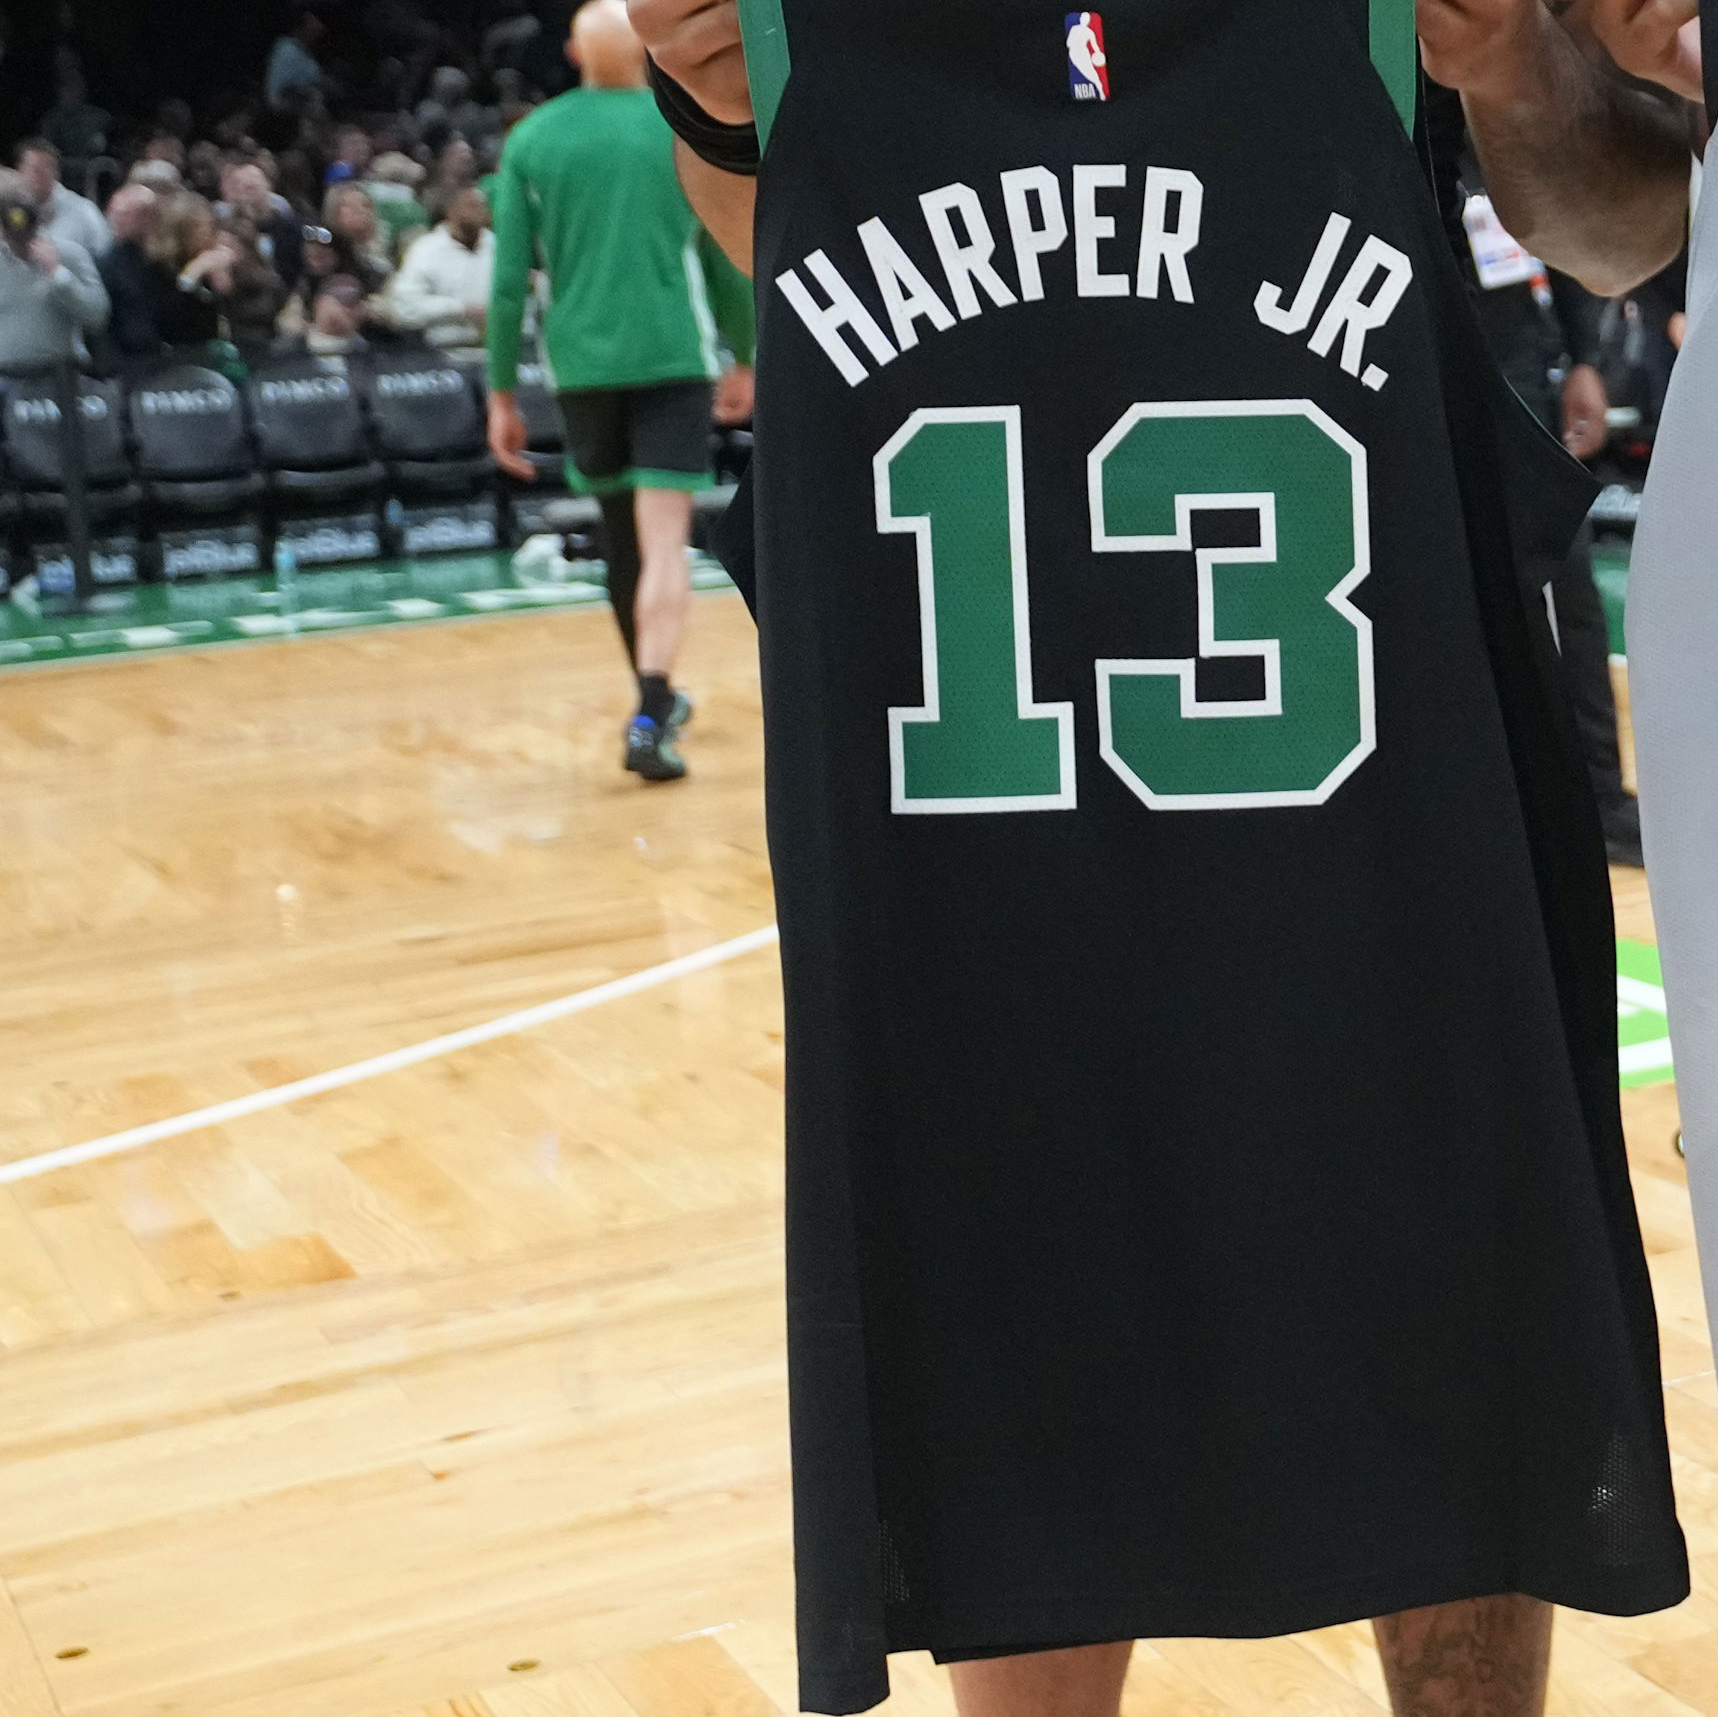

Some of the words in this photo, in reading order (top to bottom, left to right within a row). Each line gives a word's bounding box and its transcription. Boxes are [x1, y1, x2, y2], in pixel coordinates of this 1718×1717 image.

[1073, 82, 1098, 101] NBA
[775, 163, 1205, 388] HARPER
[1253, 211, 1414, 392] JR.
[872, 398, 1378, 815] 13
